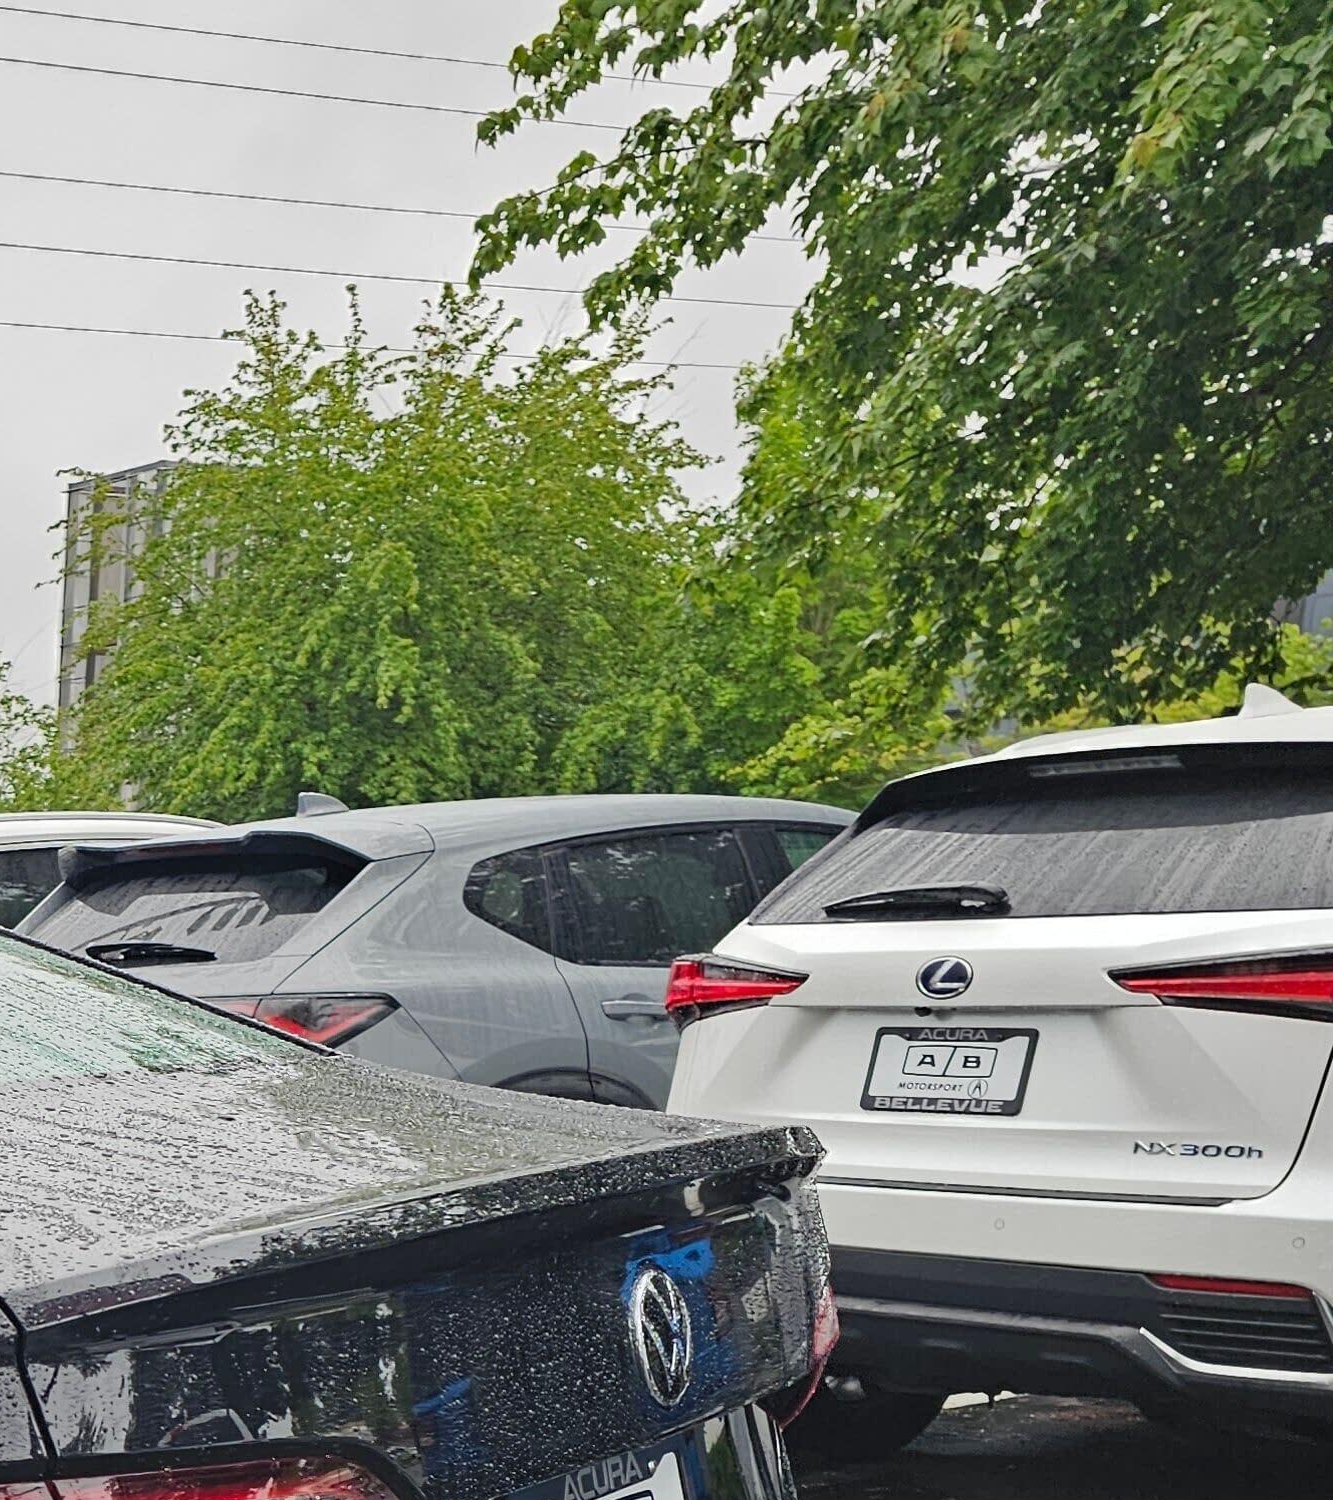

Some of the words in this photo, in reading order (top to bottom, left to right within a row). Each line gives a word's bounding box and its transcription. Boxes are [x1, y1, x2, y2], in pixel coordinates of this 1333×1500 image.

[917, 1028, 989, 1041] ACURA
[917, 1054, 936, 1067] A
[962, 1055, 981, 1069] B
[897, 1081, 964, 1092] MOTORSPORT
[873, 1096, 1005, 1113] BELLEVUE
